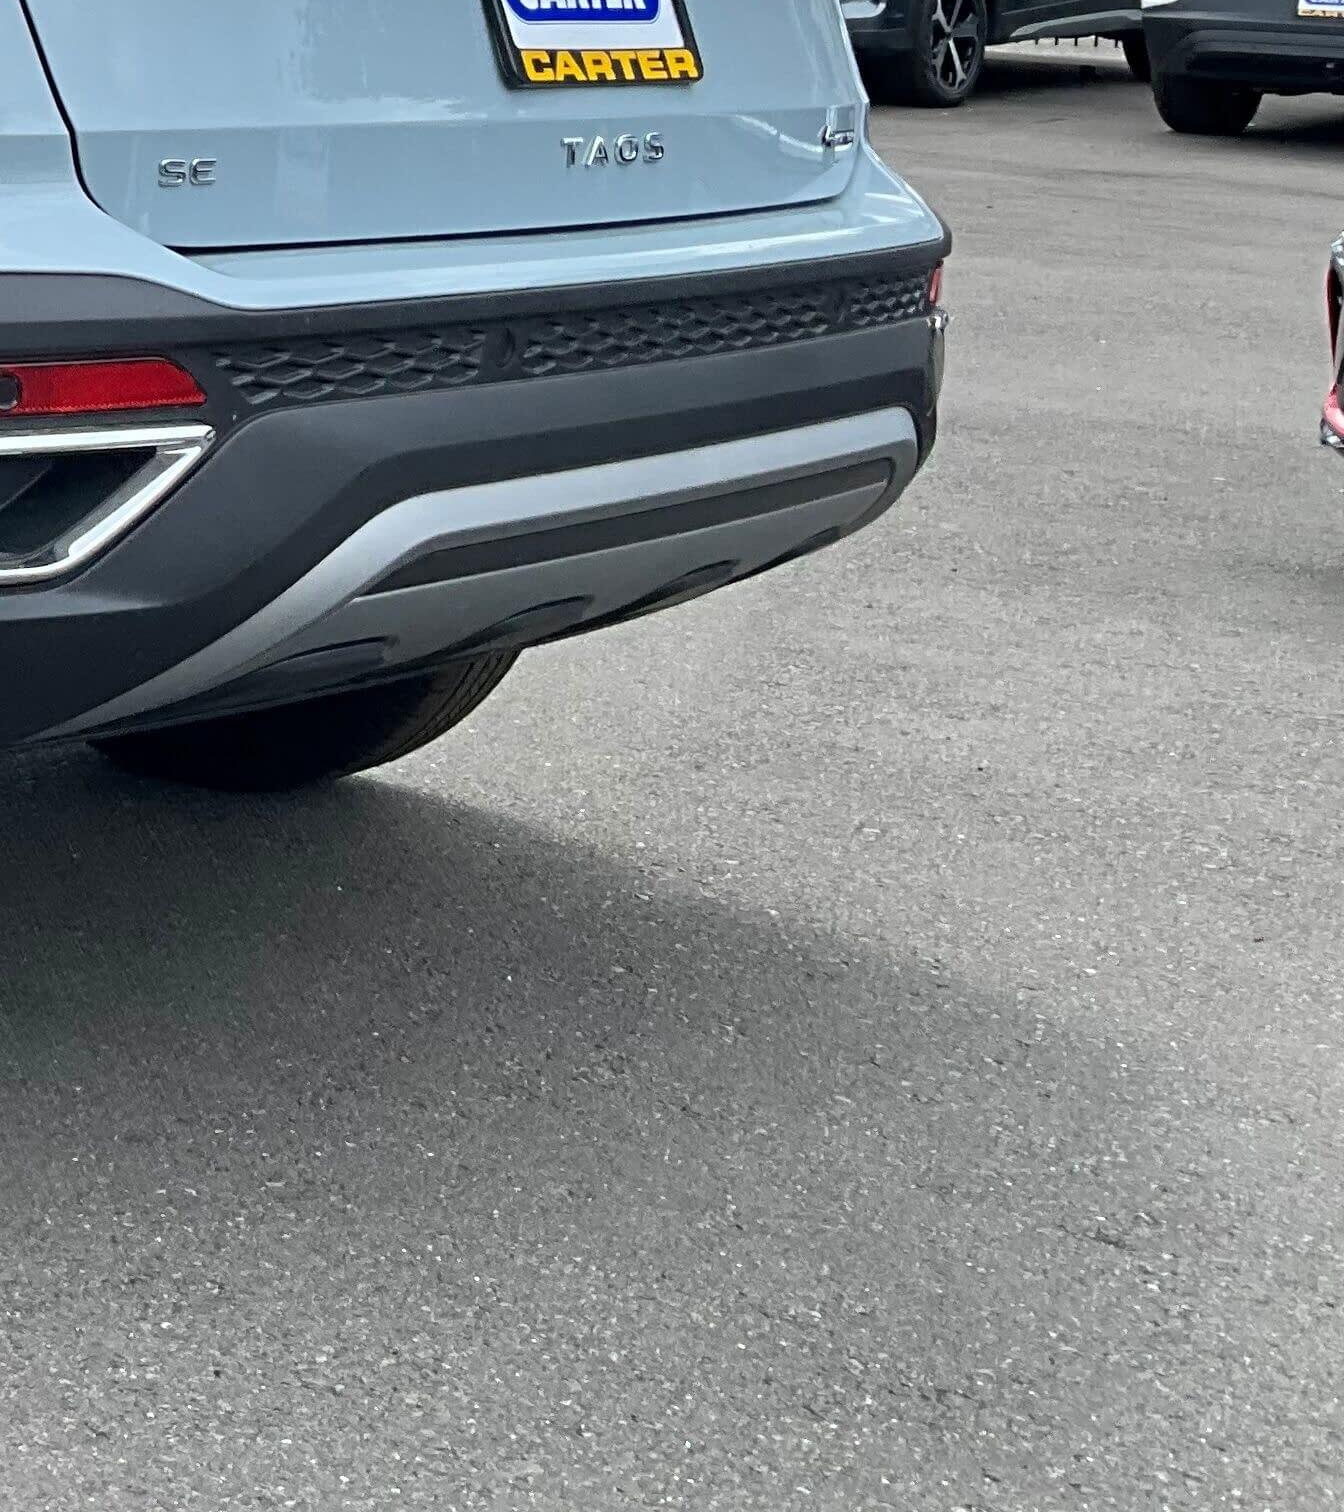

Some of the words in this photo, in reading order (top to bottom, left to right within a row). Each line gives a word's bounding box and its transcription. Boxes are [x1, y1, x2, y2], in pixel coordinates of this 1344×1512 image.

[520, 48, 699, 82] CARTER
[560, 131, 664, 168] TAOS
[158, 158, 217, 188] SE
